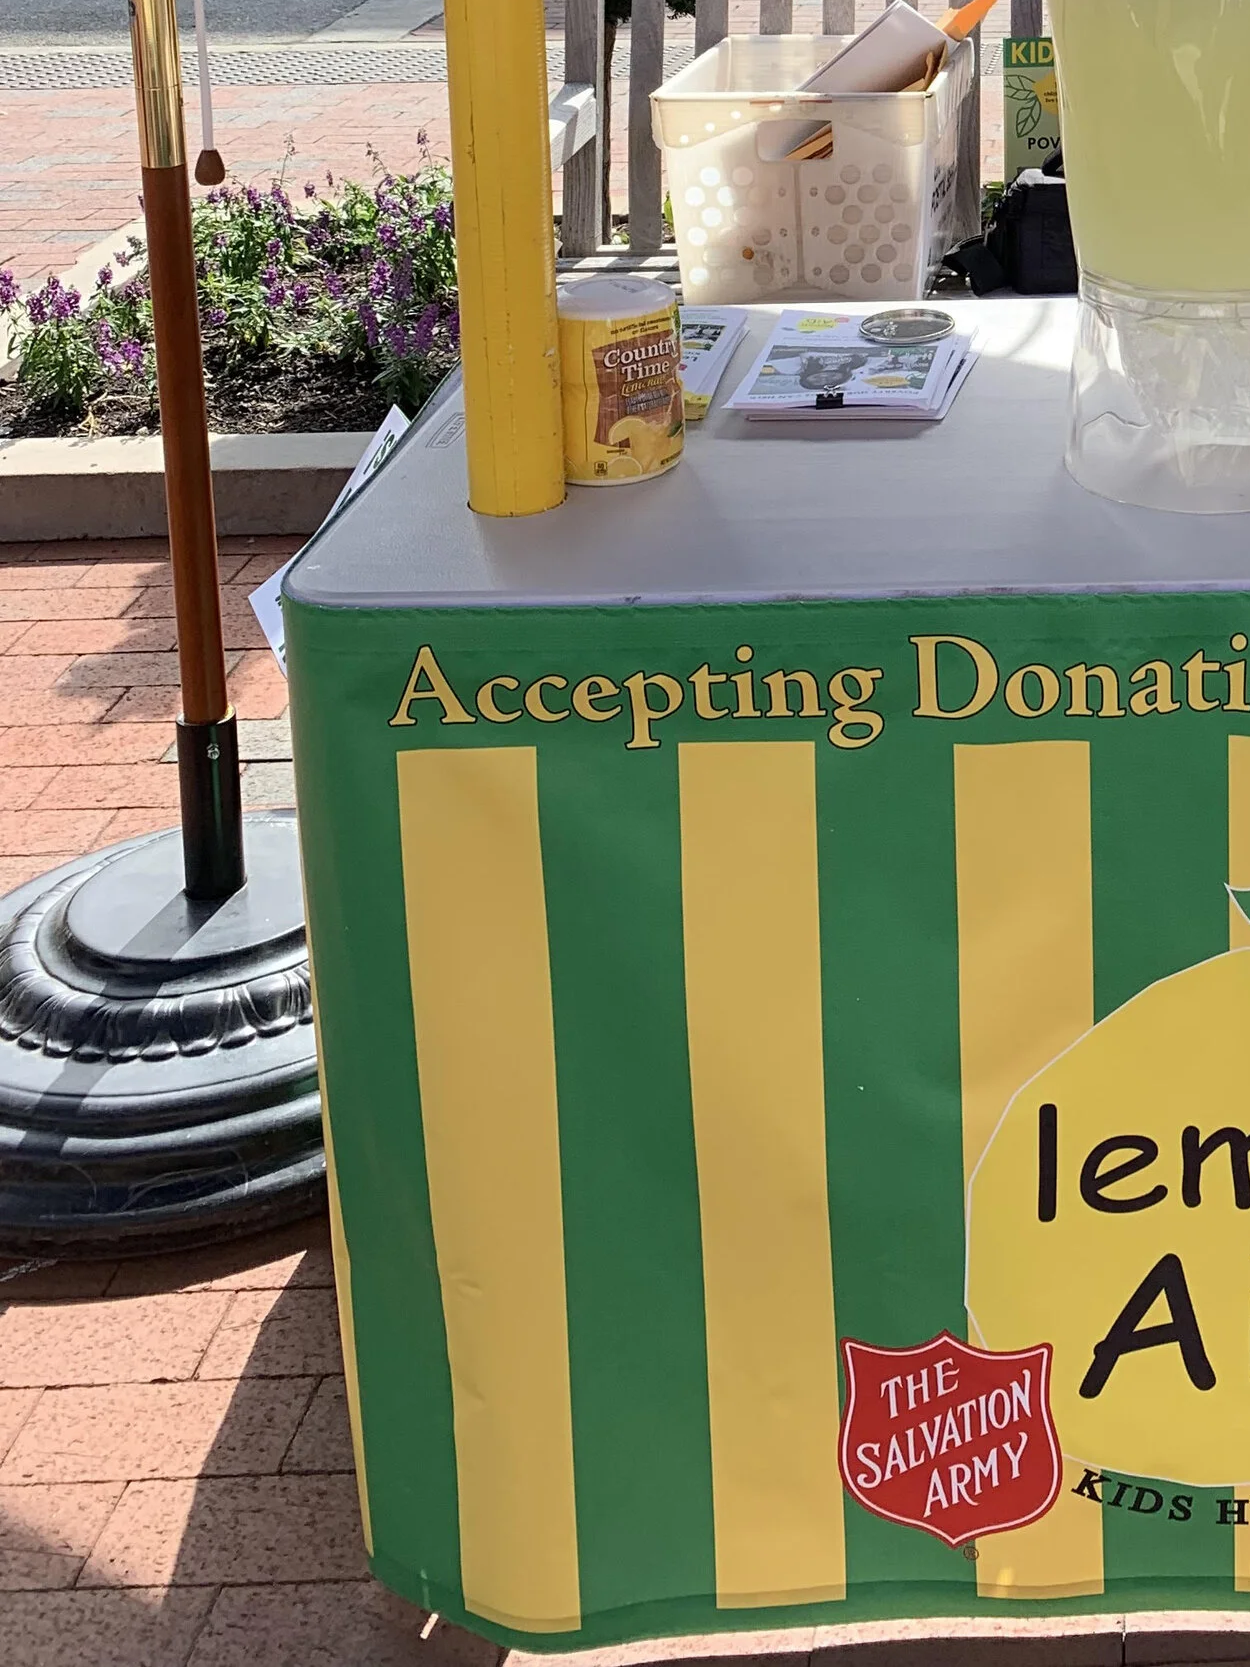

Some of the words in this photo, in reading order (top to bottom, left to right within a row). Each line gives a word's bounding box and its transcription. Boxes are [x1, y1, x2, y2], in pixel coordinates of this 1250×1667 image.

[604, 339, 679, 368] Country
[621, 360, 670, 382] Time
[387, 645, 885, 750] Accepting
[880, 1357, 962, 1419] THE
[855, 1368, 1034, 1490] SALVATION
[922, 1433, 1029, 1517] ARMY
[1072, 1468, 1194, 1522] KIDS
